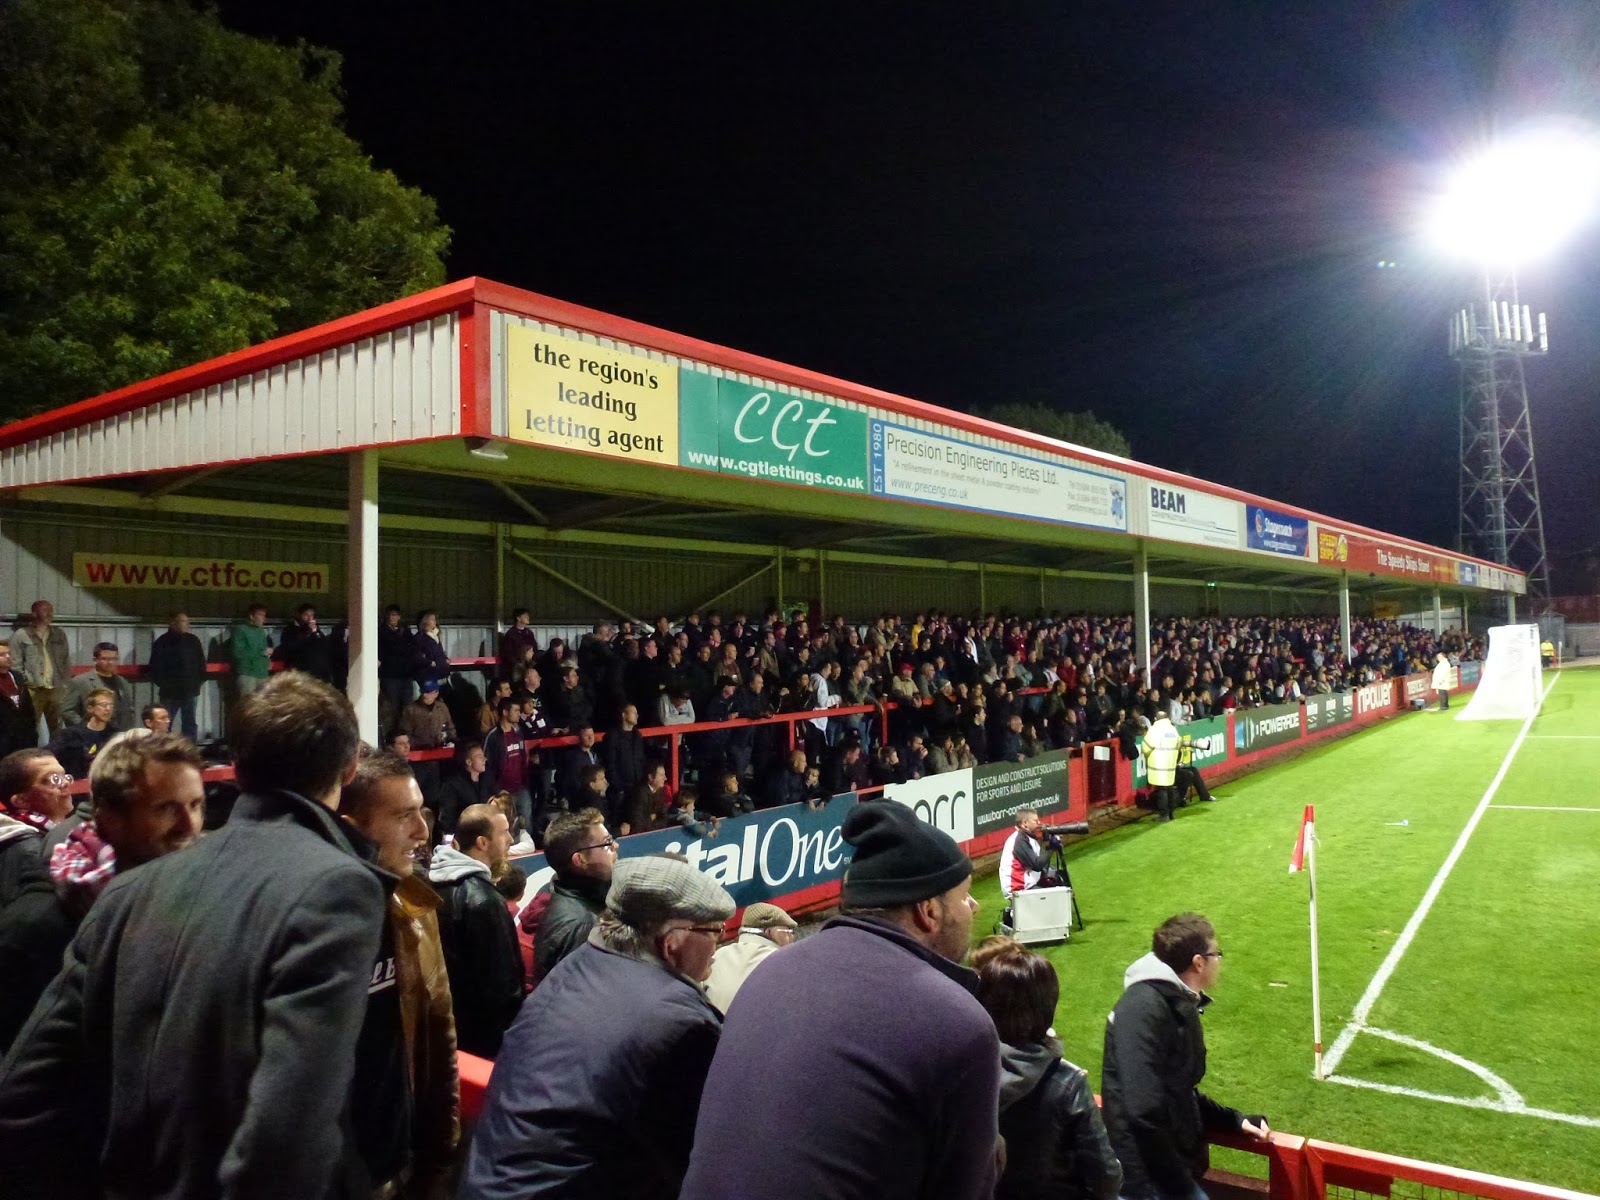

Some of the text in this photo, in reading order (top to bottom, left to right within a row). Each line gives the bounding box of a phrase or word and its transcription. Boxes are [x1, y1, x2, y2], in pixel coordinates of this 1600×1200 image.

[534, 342, 659, 390] the region's
[557, 382, 637, 421] leading
[525, 409, 664, 453] letting agent
[688, 451, 864, 491] www.cgtlettings.co.uk
[872, 422, 883, 492] EST 1980
[887, 432, 1059, 485] Precision Engineering Pieces Ltd.
[901, 461, 931, 476] refinement
[940, 469, 949, 479] the
[891, 477, 968, 499] www.preceng.co.uk
[1151, 487, 1186, 514] BEAM
[1376, 549, 1387, 565] The
[85, 562, 322, 590] www.ctfc.com
[1259, 712, 1300, 737] POWERADE
[976, 760, 1066, 790] DESIGN AND CONSTRUCT SOLUTIONS
[976, 777, 1042, 803] FOR SPORTS AND LEISURE
